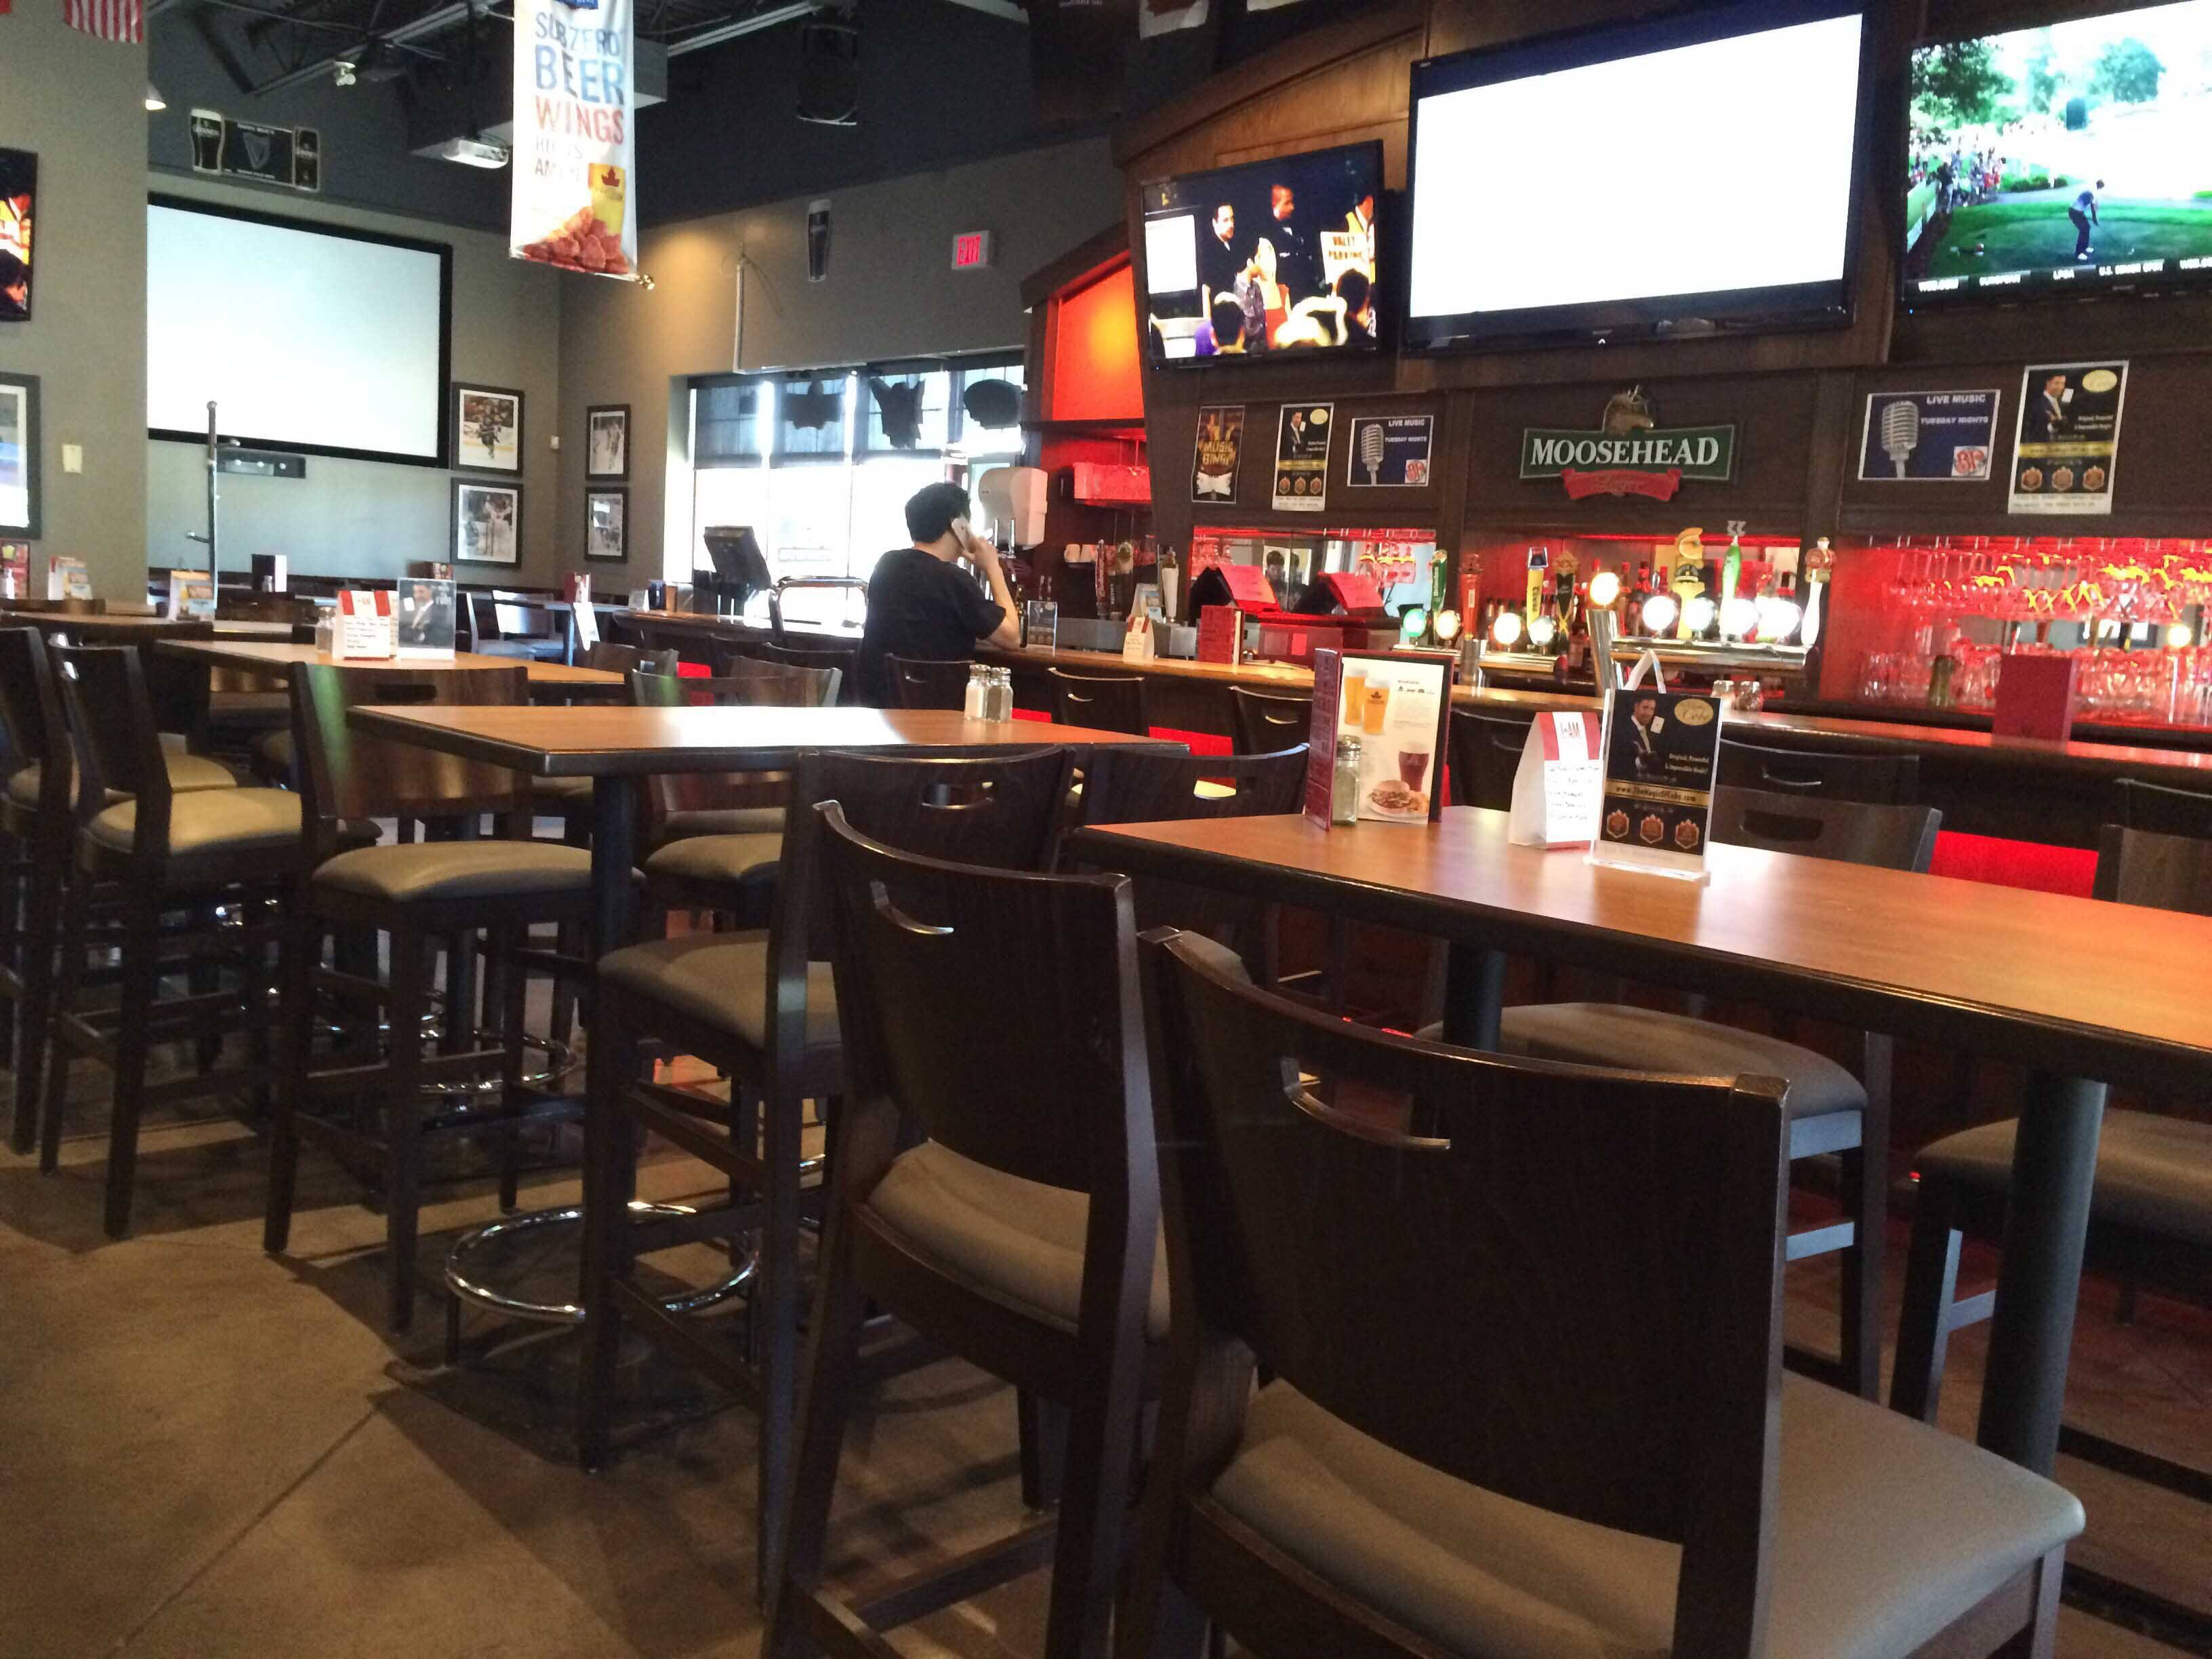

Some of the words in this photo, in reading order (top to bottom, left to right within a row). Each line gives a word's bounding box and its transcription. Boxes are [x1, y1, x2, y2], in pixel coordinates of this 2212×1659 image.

[534, 43, 625, 106] BEER
[535, 95, 625, 146] WINGS
[956, 234, 982, 266] EXIT
[1926, 395, 1950, 405] LIVE
[1952, 394, 1986, 403] MUSIC
[1404, 418, 1425, 426] MUSIC
[1530, 436, 1720, 466] MOOSEHEAD
